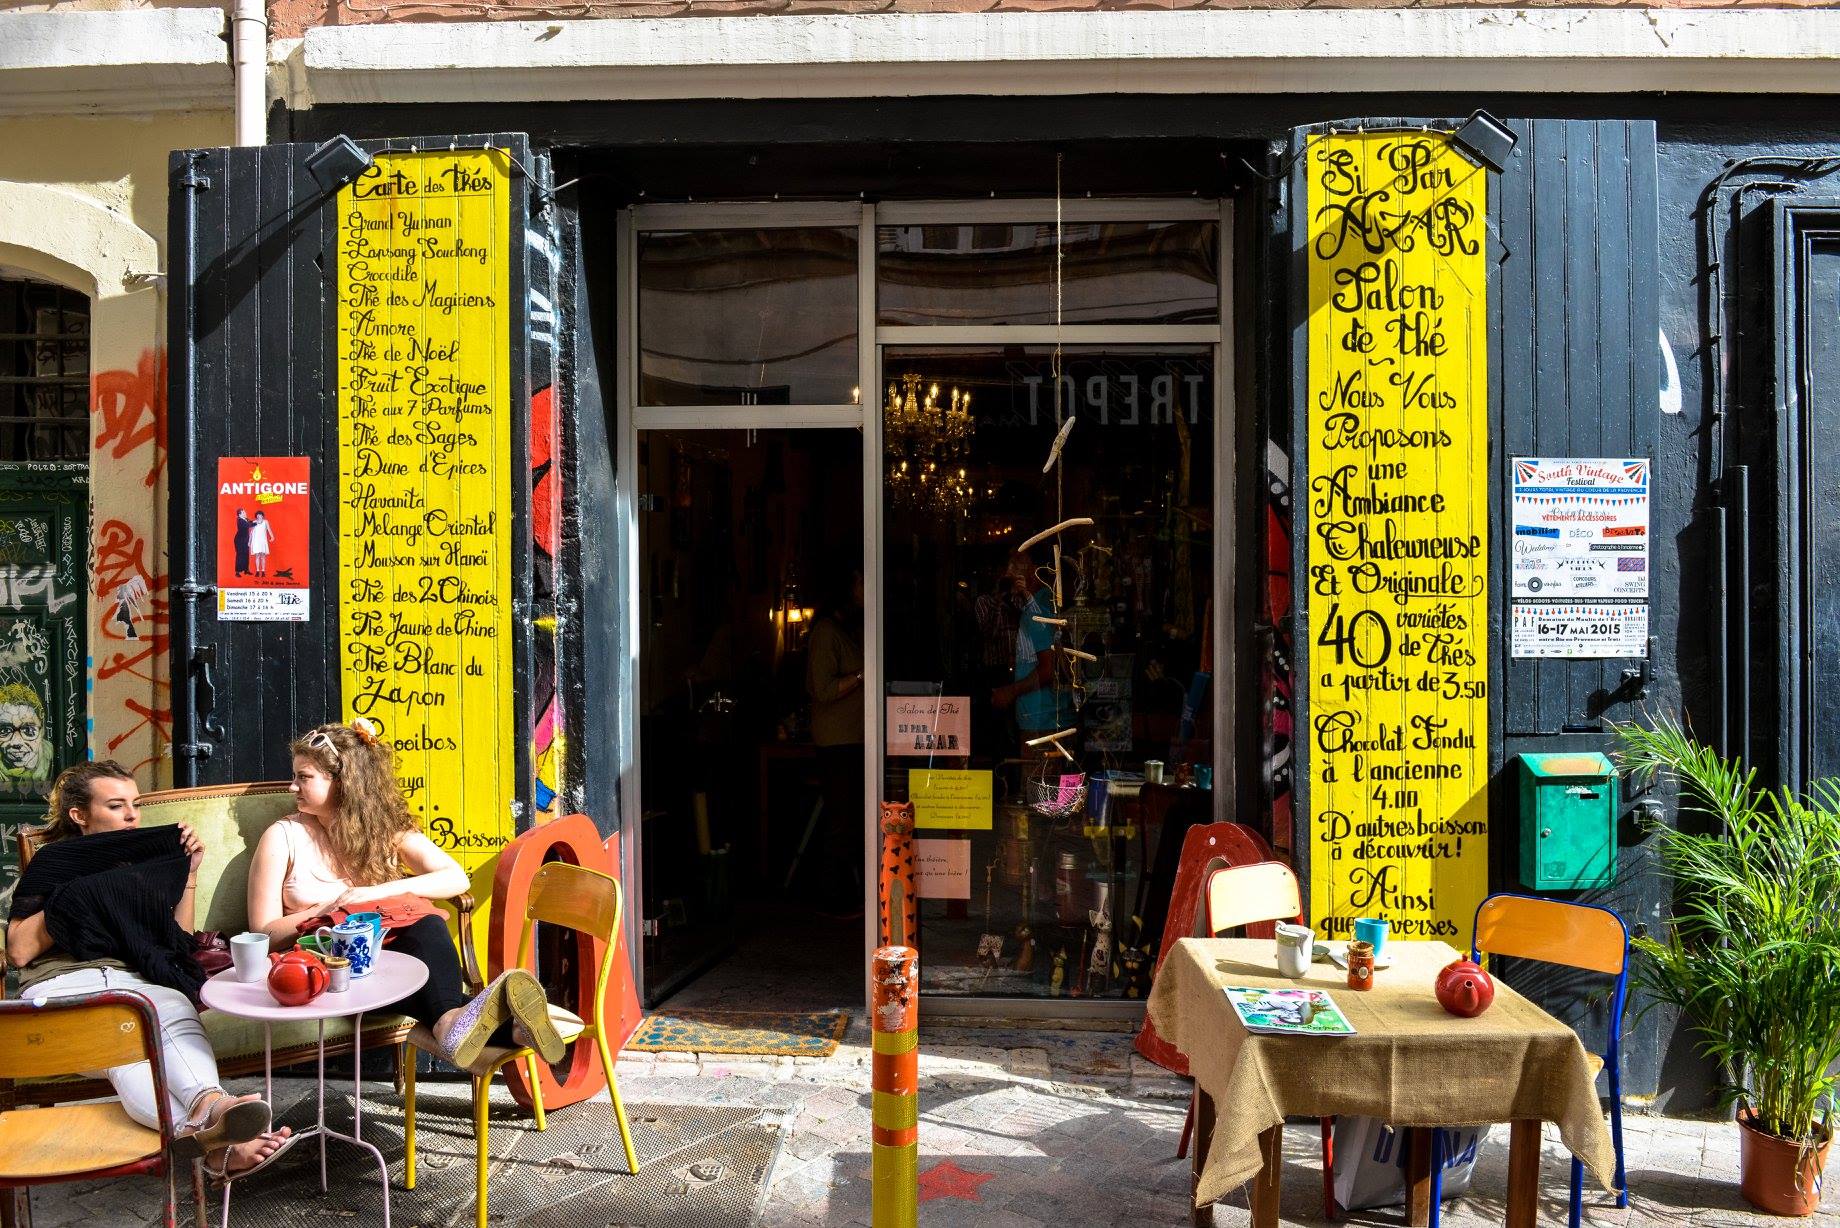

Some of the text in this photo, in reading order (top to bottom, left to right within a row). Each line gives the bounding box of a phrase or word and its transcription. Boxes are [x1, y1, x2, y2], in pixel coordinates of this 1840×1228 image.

[352, 164, 418, 198] Carte
[424, 176, 444, 193] des
[1317, 139, 1457, 196] Si Par
[348, 211, 452, 239] Grand Yunnan
[346, 238, 487, 265] Lapsang Souchong
[347, 261, 418, 282] Crocodile
[1332, 259, 1444, 312] Salon
[387, 290, 409, 306] des
[413, 279, 495, 315] Magiciens
[350, 309, 416, 336] Amore
[1341, 317, 1377, 353] de
[349, 337, 460, 362] Thé de Noël
[350, 366, 487, 401] Fruit Exotique
[1319, 370, 1457, 411] Nous Vous
[350, 395, 492, 423] Thé aux 7 Parfums
[352, 421, 478, 453] Thé des Sages
[1322, 412, 1452, 461] Proposons
[353, 448, 410, 478] Dune
[1368, 462, 1408, 480] une
[1538, 464, 1624, 484] South Vintage
[220, 482, 308, 495] ANTIGONE
[350, 482, 425, 509] Havanita
[1312, 465, 1446, 518] Ambiance
[1566, 477, 1596, 486] Festival
[423, 509, 496, 536] Oriental
[1316, 518, 1481, 561] Chaleureuse
[354, 540, 488, 568] Mousson sur Hanoï
[393, 583, 417, 603] des
[418, 576, 438, 604] 2
[437, 576, 498, 605] Chinois
[1311, 561, 1483, 605] Et Originale
[385, 611, 433, 647] Jaune
[436, 617, 452, 636] de
[454, 609, 497, 638] Chine
[1317, 603, 1392, 668] 40
[1538, 624, 1568, 635] 16-17
[1591, 624, 1620, 634] 2015
[348, 641, 484, 676] Thé Blanc du
[1399, 634, 1421, 656] de
[1340, 666, 1411, 702] partir
[1417, 670, 1440, 692] de
[1442, 672, 1486, 700] 3.50
[897, 703, 959, 714] Salon de Thé
[911, 725, 928, 733] PAR
[914, 735, 959, 749] AZAR
[1314, 710, 1476, 753] Chocolat Fondu
[1322, 758, 1338, 783] à
[1372, 784, 1418, 809] 4.00
[430, 818, 509, 849] Boissons
[1349, 865, 1436, 911] Ainsi
[1320, 912, 1458, 940] que verses
